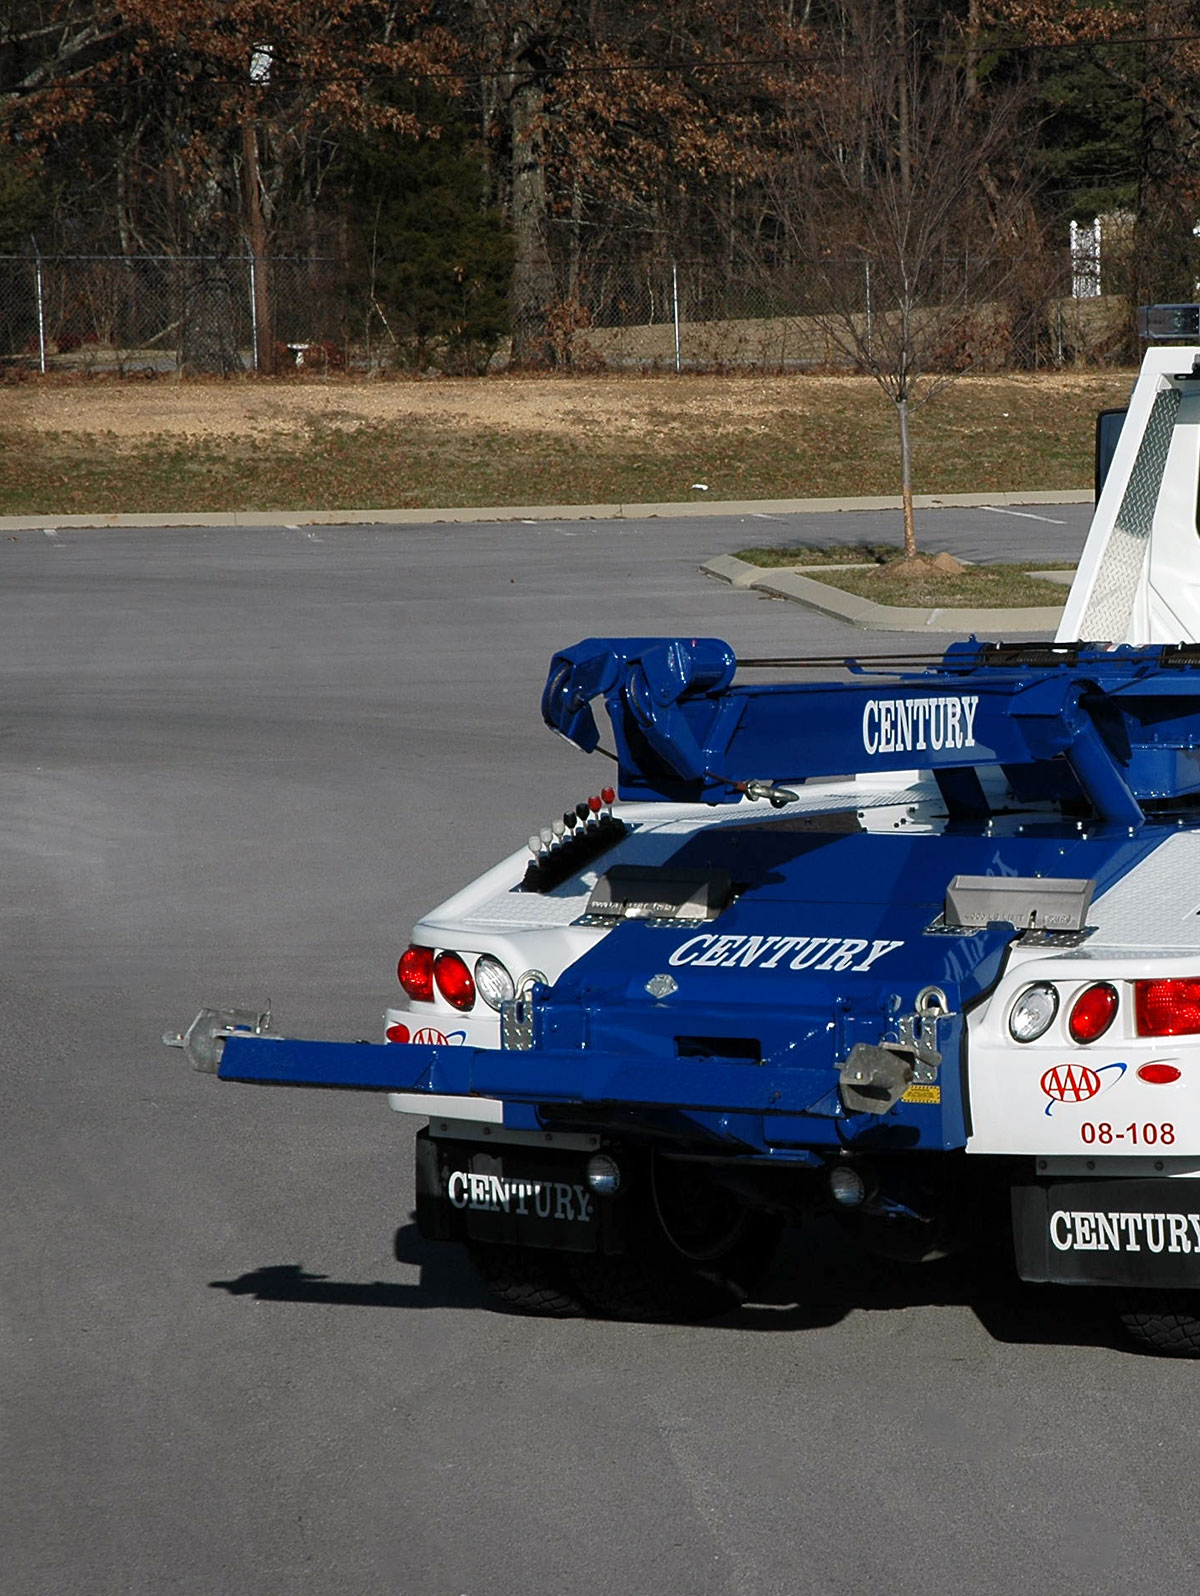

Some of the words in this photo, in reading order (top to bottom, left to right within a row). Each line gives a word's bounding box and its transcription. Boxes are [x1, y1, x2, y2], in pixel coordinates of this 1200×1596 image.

[862, 695, 980, 755] CENTURY
[668, 933, 904, 972] CENTURY
[1040, 1063, 1101, 1103] AAA
[1081, 1122, 1176, 1145] 08-108
[448, 1171, 593, 1222] CENTURY
